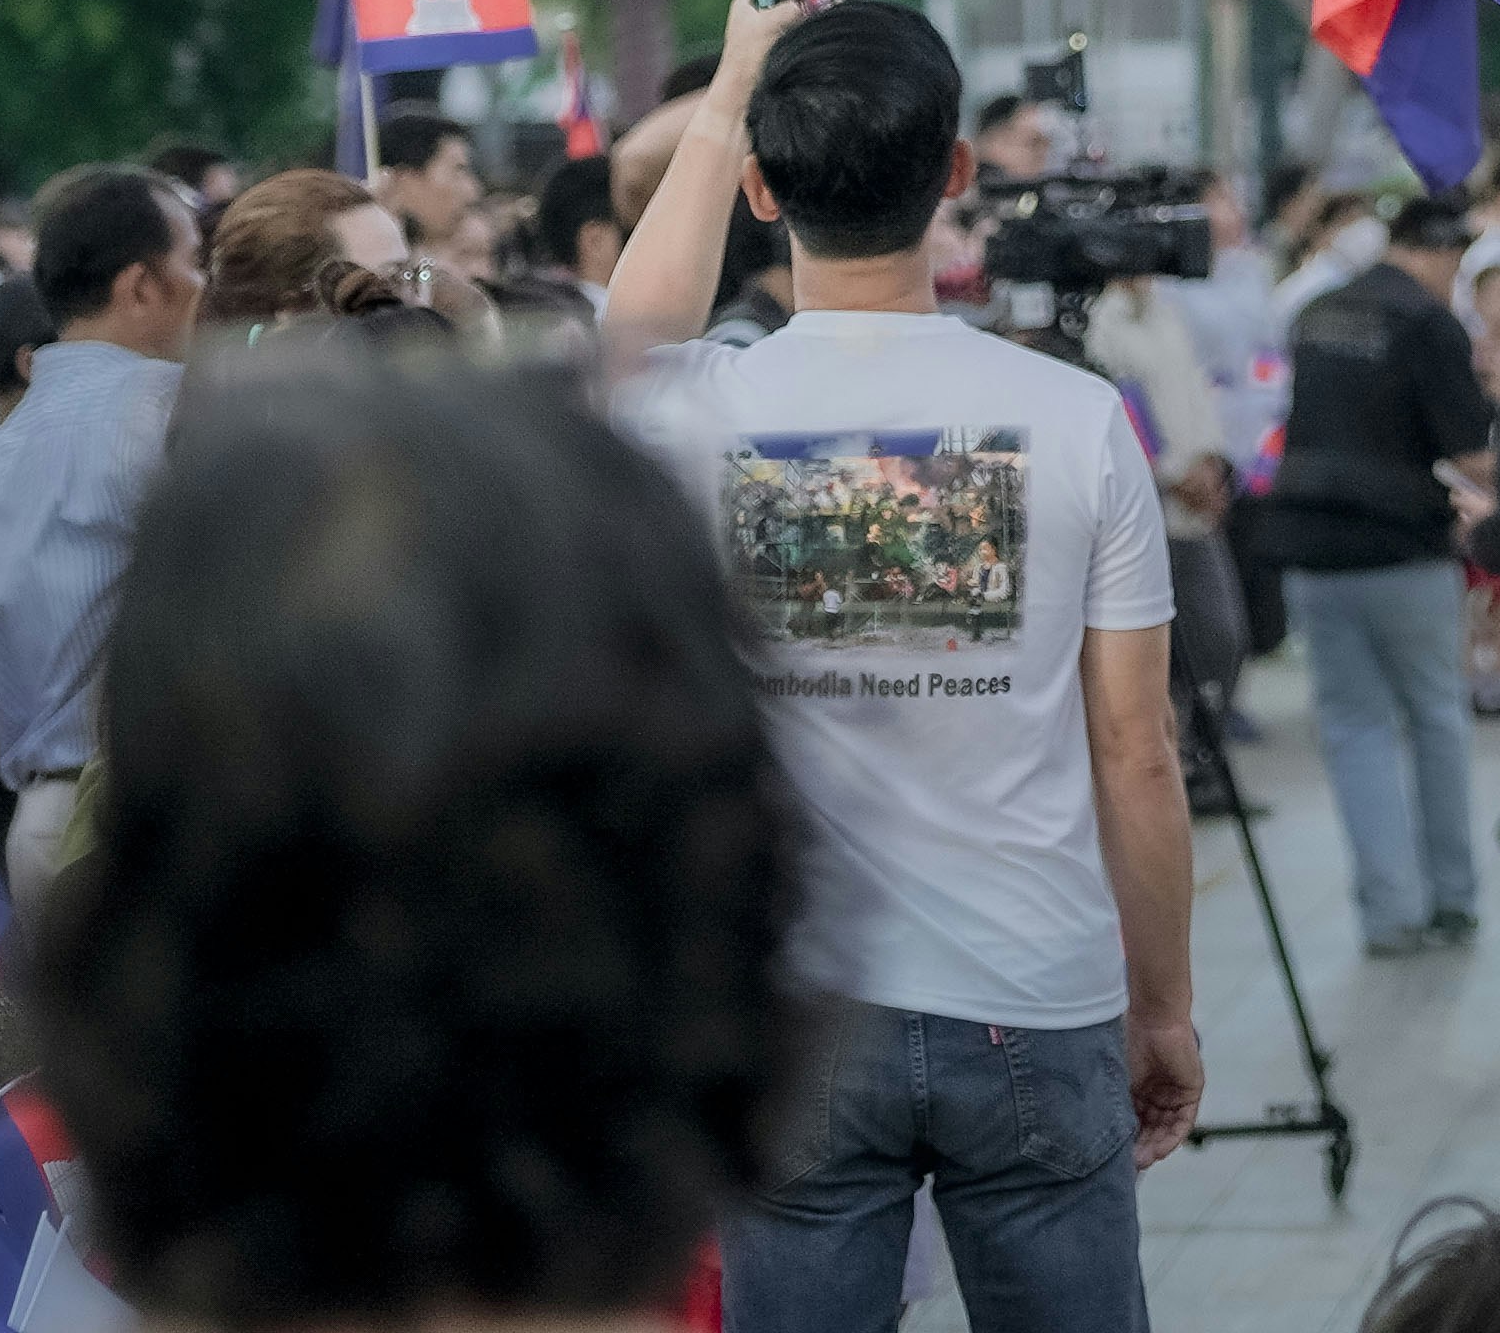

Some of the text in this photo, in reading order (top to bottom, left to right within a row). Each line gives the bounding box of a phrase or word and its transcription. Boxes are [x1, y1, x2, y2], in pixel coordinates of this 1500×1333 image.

[751, 670, 1011, 697] ambodia Need Peaces
